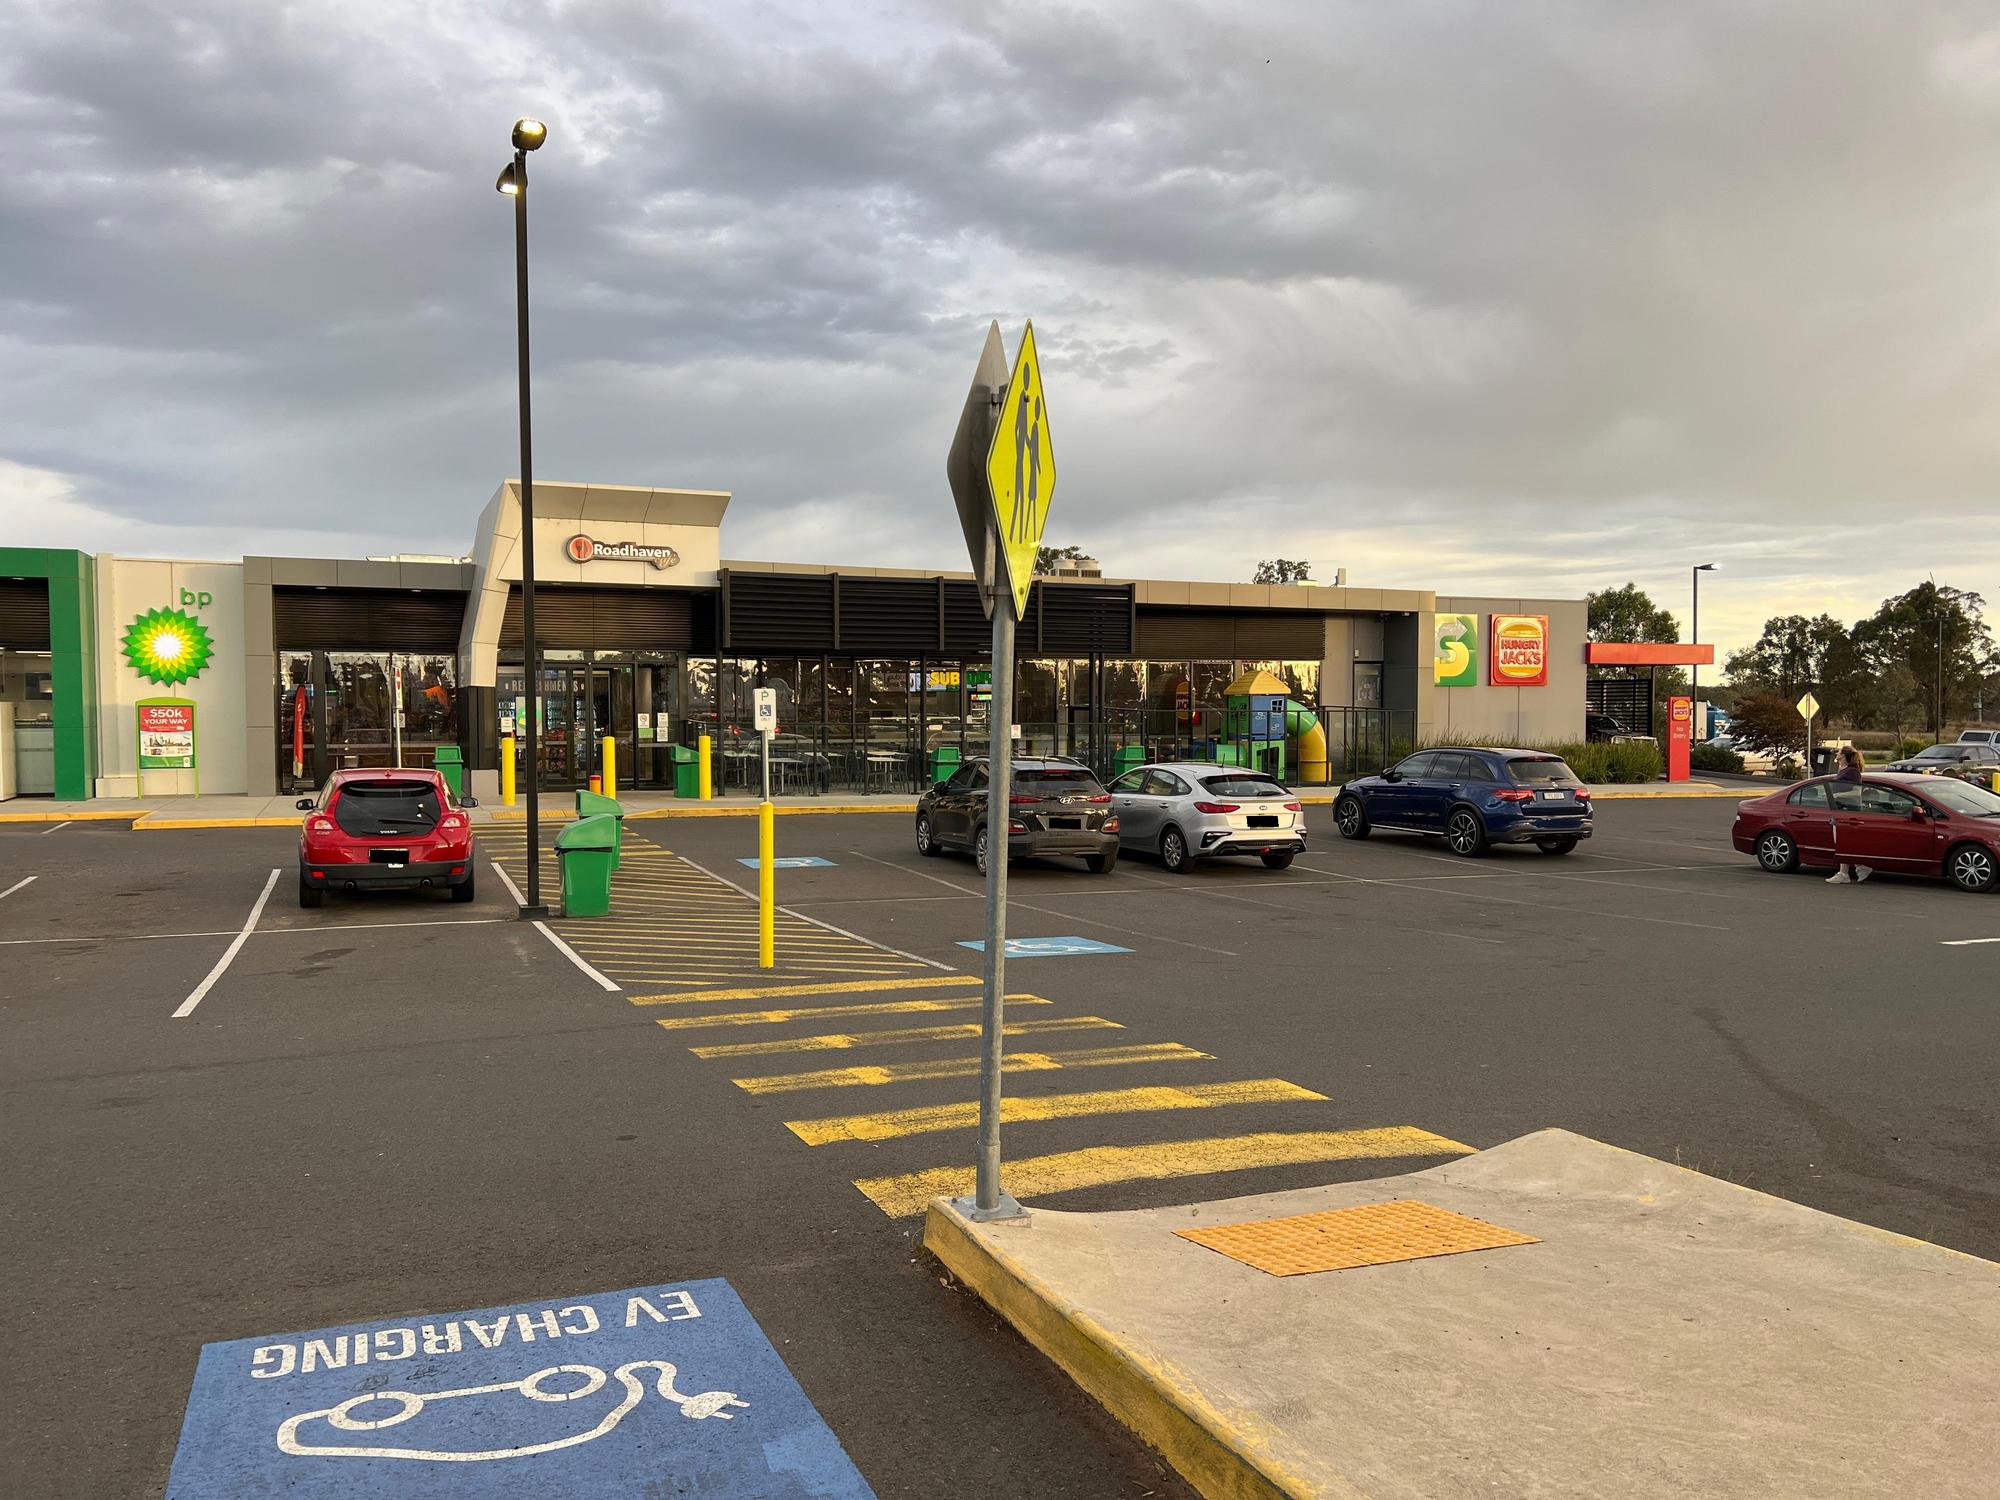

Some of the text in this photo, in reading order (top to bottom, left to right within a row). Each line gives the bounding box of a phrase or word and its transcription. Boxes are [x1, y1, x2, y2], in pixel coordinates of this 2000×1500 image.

[594, 544, 671, 557] Roadhaven
[180, 587, 212, 609] bp
[1501, 640, 1541, 650] HUNGRY
[1501, 651, 1541, 665] JACK'S
[150, 708, 183, 718] $50k
[250, 1290, 702, 1379] EV CHARGING
